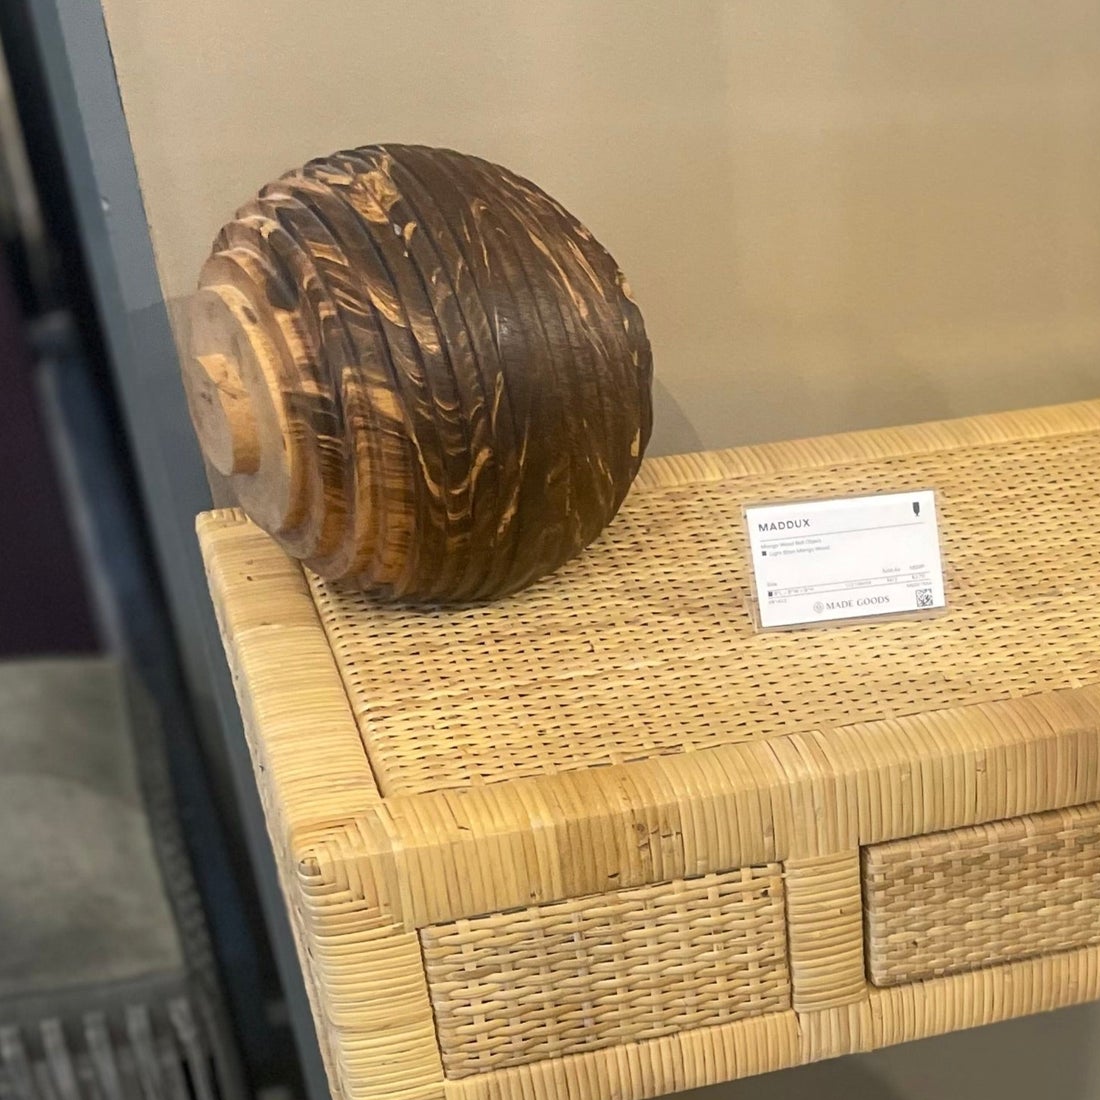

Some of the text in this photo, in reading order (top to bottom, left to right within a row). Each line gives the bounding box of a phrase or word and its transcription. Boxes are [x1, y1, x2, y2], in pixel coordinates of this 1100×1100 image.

[758, 519, 811, 532] MADDUX
[826, 596, 890, 610] MADE GOODS
